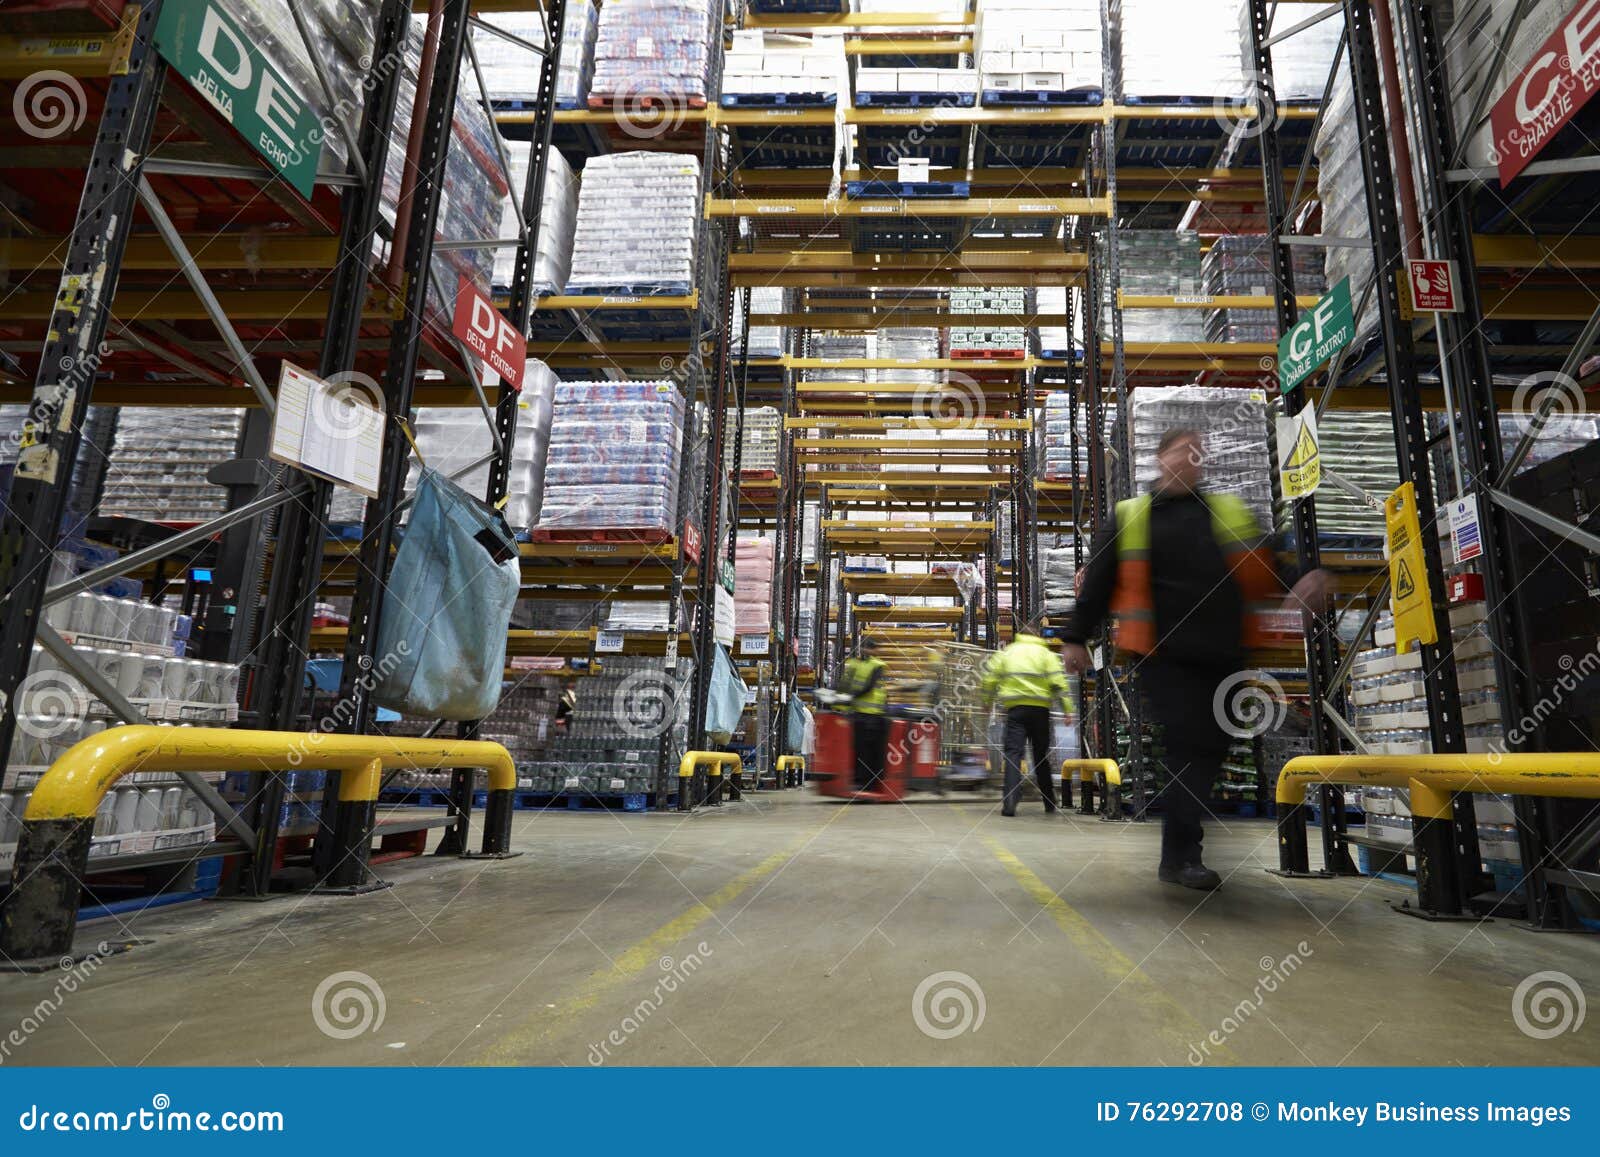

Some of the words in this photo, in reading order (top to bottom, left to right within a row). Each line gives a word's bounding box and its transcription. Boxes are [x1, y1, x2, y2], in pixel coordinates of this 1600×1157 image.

[197, 5, 301, 150] DE
[198, 69, 234, 113] DELTA
[259, 132, 288, 169] ECHO
[1519, 92, 1573, 158] CHARLIE
[471, 293, 516, 353] DF
[1289, 295, 1334, 361] CF
[466, 328, 486, 355] DELTA
[490, 350, 517, 382] FOXTROT
[1286, 357, 1312, 387] CHARLIE
[1315, 325, 1347, 362] FOXTROT
[600, 639, 620, 647] BLUE
[745, 641, 766, 649] BLUE
